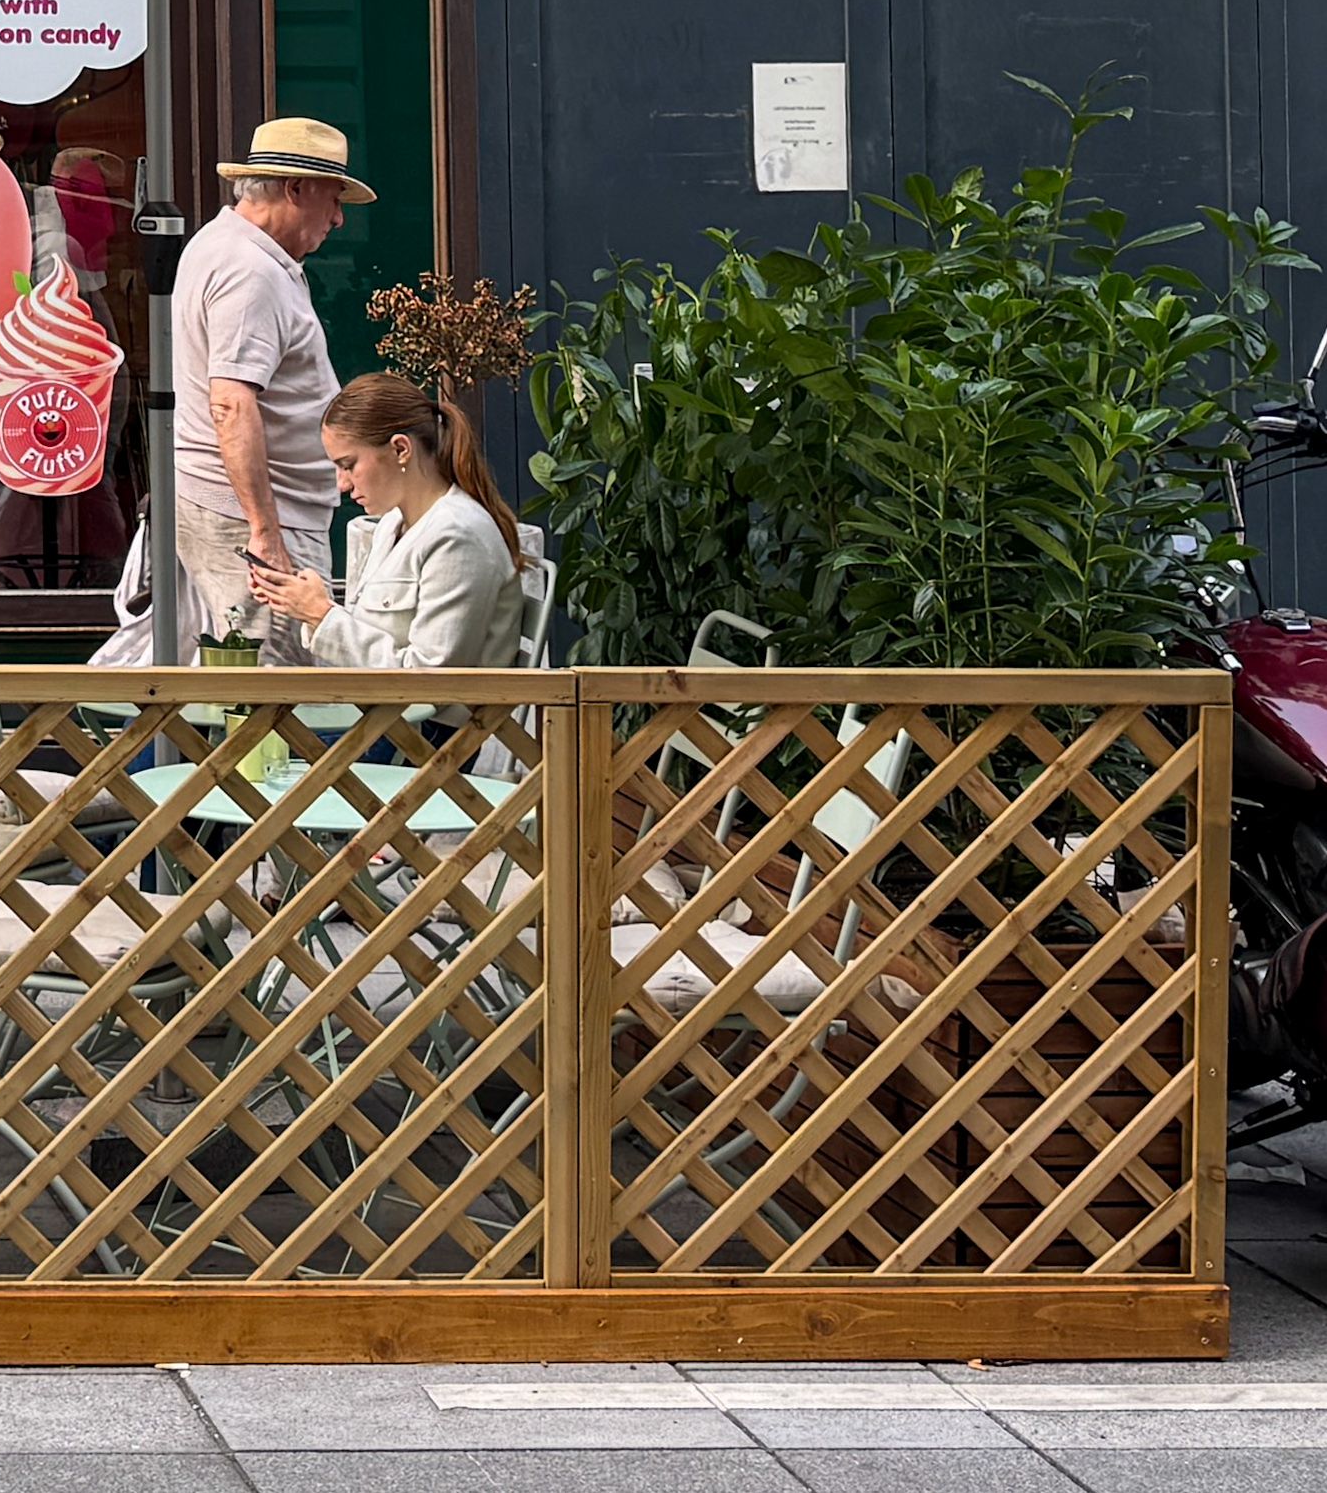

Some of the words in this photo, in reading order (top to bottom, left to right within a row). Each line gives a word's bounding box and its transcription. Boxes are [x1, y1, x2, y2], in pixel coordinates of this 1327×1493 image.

[40, 22, 122, 51] candy
[16, 386, 79, 417] Puffy
[19, 444, 85, 475] Fluffy
